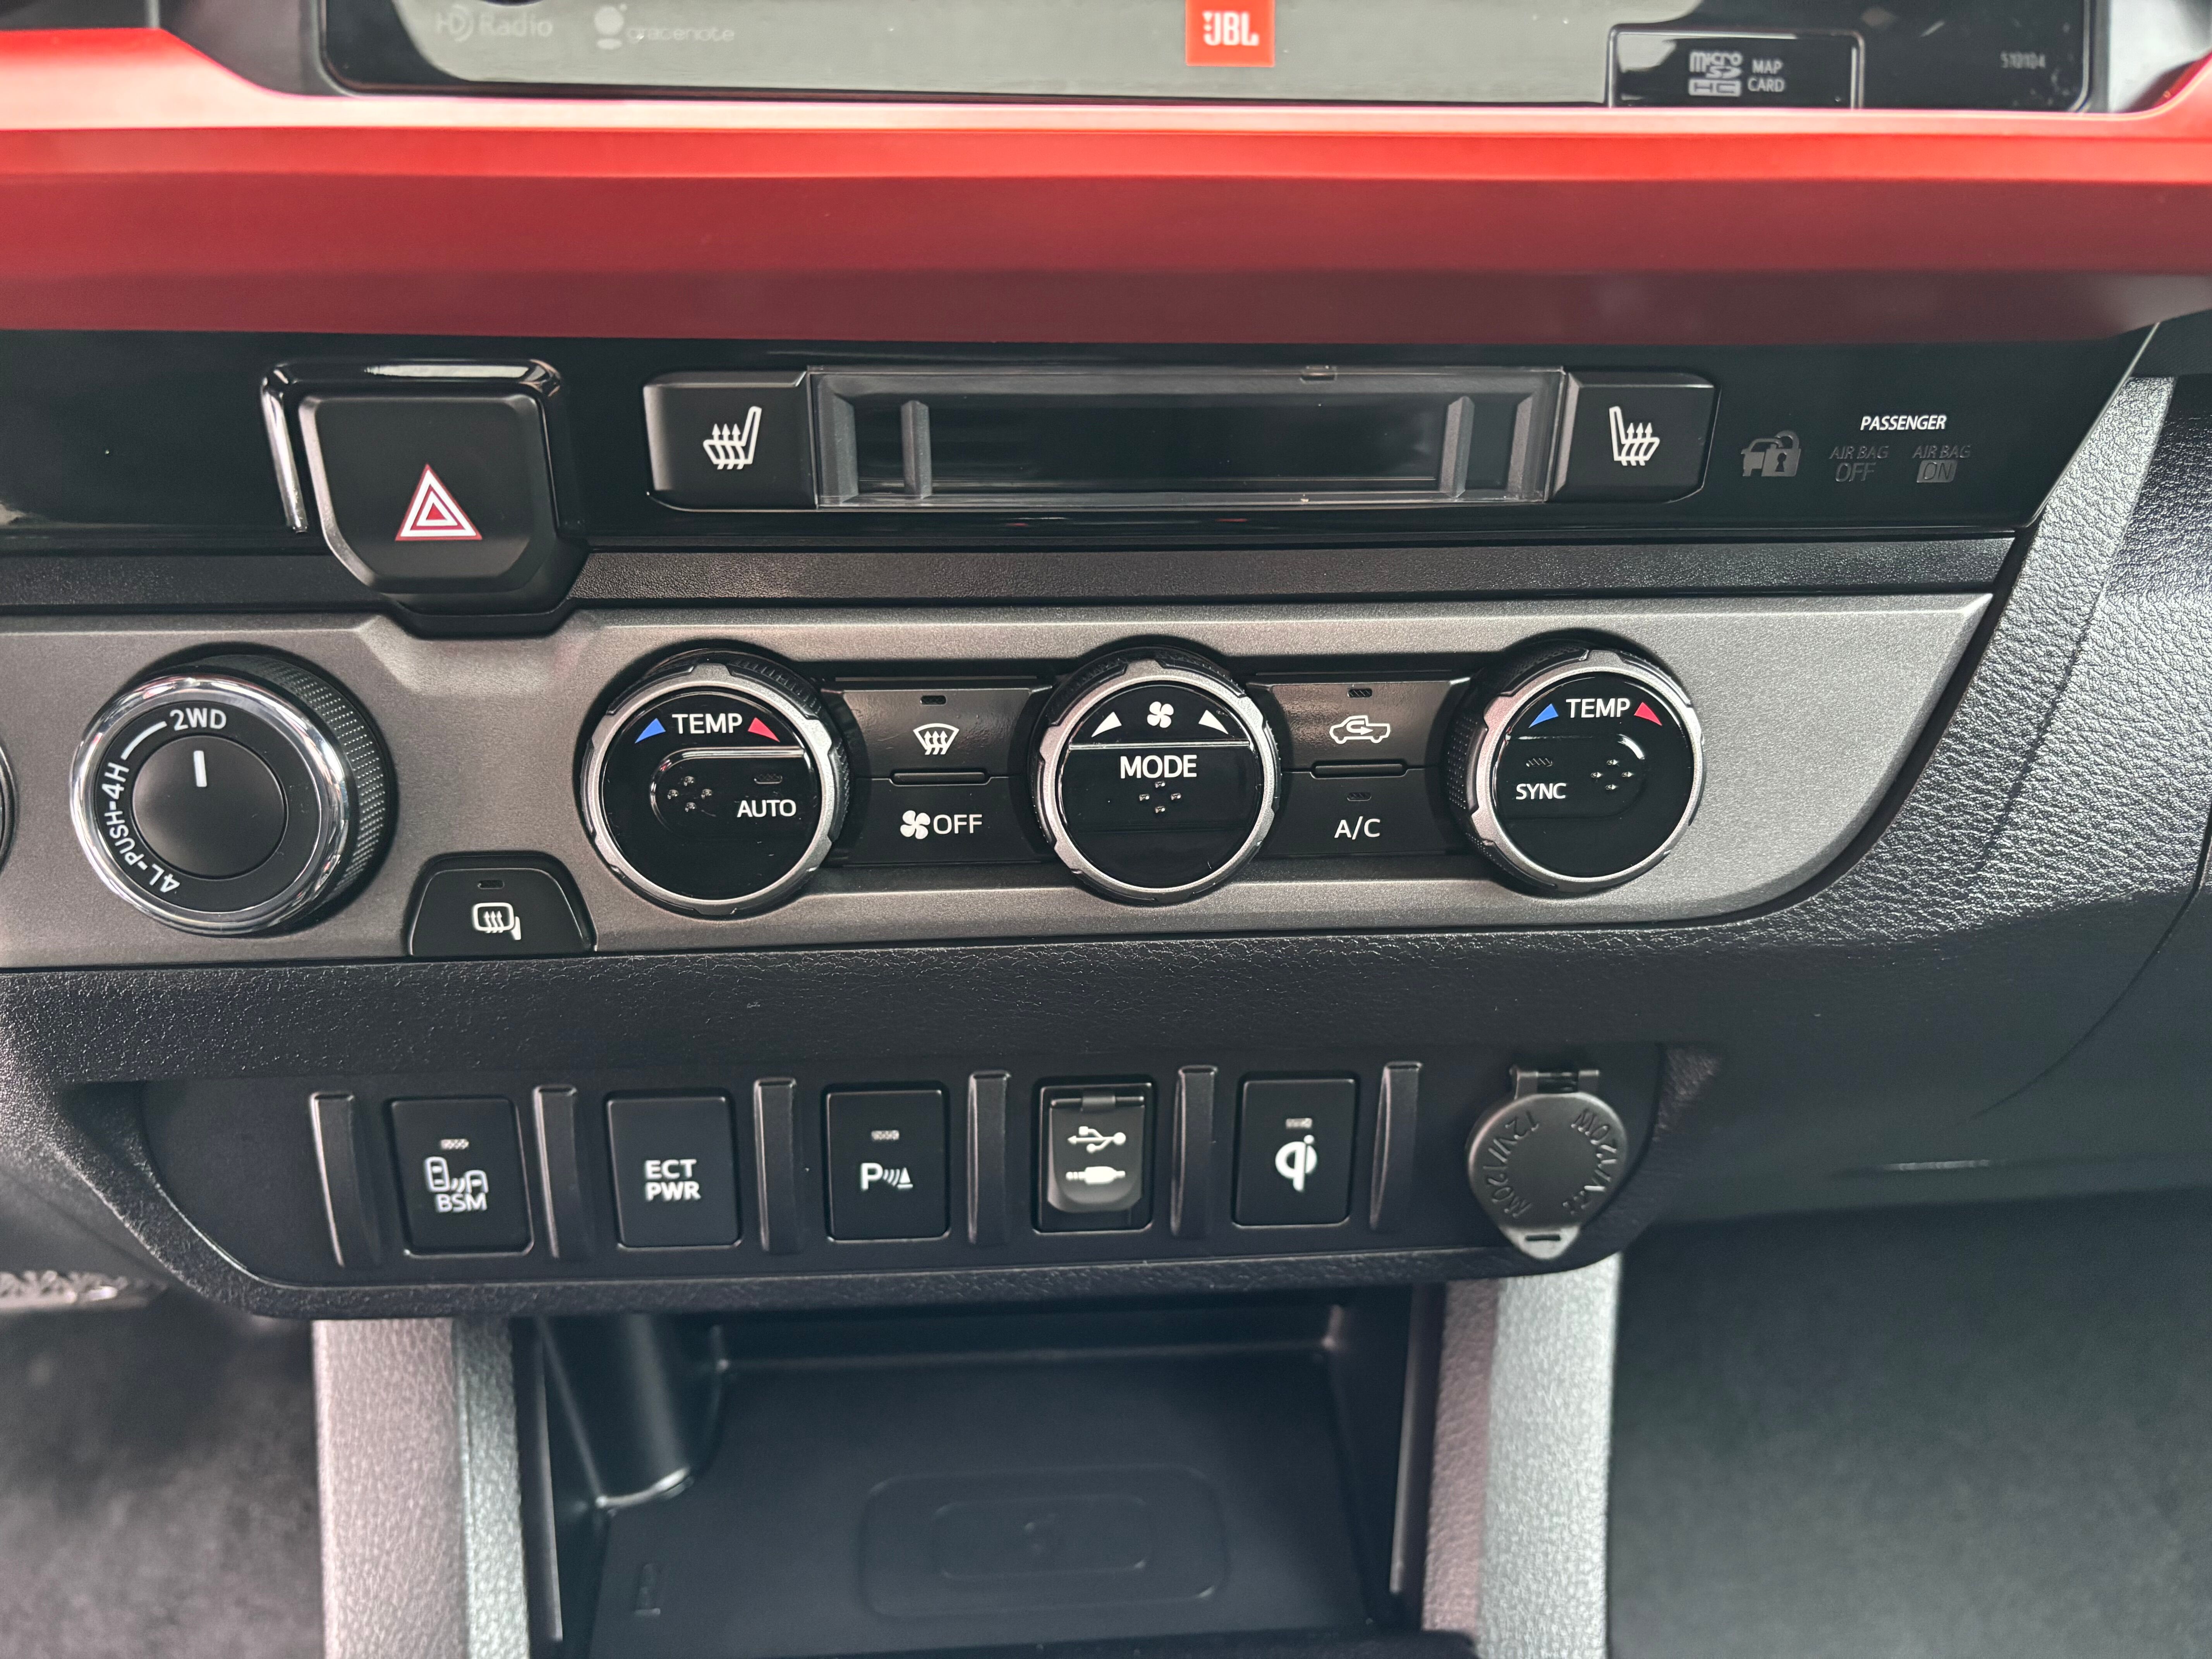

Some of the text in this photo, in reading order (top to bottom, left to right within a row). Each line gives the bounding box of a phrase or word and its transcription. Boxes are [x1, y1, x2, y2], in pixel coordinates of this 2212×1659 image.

[479, 11, 553, 38] Radio
[1203, 11, 1259, 46] JBL
[626, 28, 735, 44] gracenote
[1752, 59, 1783, 74] MAP
[1747, 77, 1786, 93] CARD
[1860, 415, 1947, 431] PASSENGER
[1829, 445, 1889, 459] AIR BAG
[1912, 445, 1972, 459] AIR BAG
[1835, 462, 1877, 482] OFF
[1923, 462, 1952, 480] ON
[1565, 697, 1631, 718] TEMP
[169, 708, 227, 731] 2WD
[671, 713, 743, 734] TEMP
[1120, 754, 1197, 779] MODE
[1515, 782, 1567, 800] SYNC
[736, 799, 797, 818] AUTO
[933, 814, 983, 835] OFF
[1334, 816, 1381, 840] A/C
[644, 1158, 697, 1180] ECT
[645, 1180, 701, 1201] PWR
[435, 1193, 488, 1213] BSM
